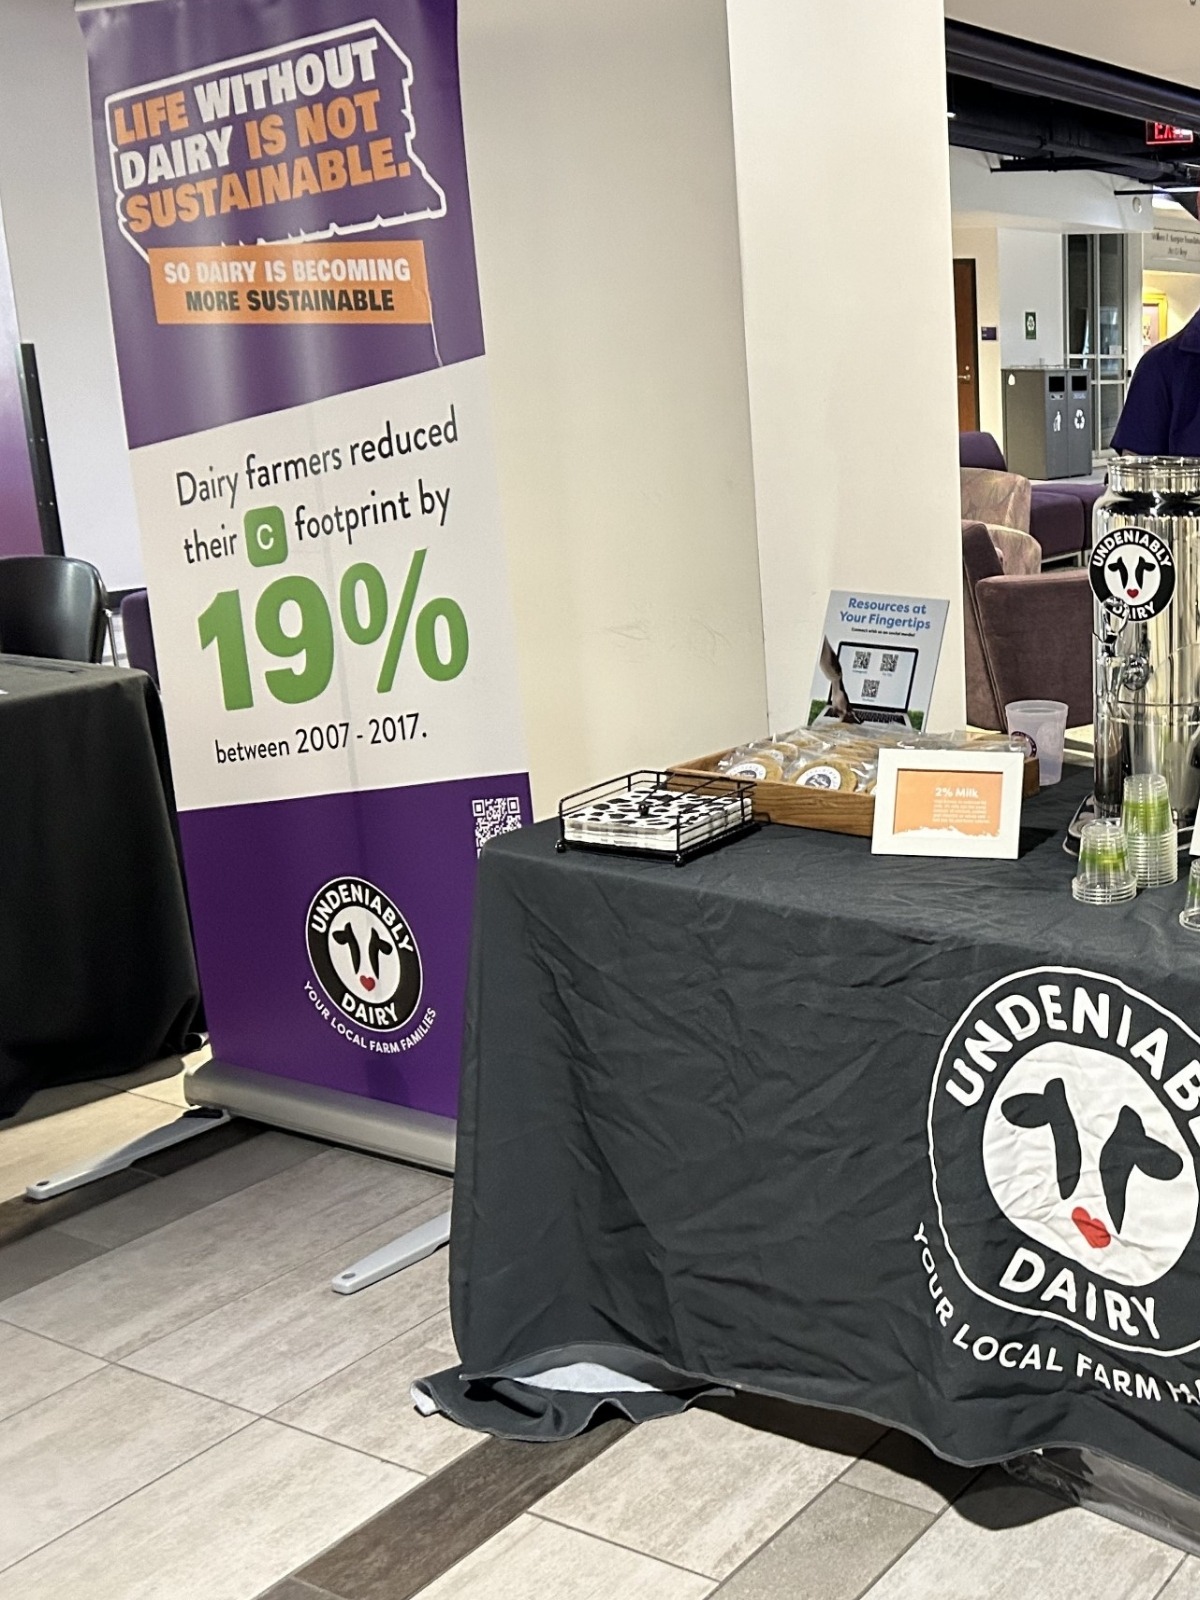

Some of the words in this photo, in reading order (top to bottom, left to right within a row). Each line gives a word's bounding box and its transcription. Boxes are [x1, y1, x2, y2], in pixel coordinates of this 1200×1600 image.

[113, 91, 188, 145] LIFE
[194, 37, 378, 123] WITHOUT
[119, 126, 233, 189] DAIRY
[245, 114, 287, 159] IS
[295, 89, 380, 148] NOT
[122, 137, 411, 233] SUSTAINABLE.
[164, 261, 189, 284] SO
[198, 260, 256, 283] DAIRY
[264, 260, 286, 282] IS
[293, 258, 410, 282] BECOMING
[186, 290, 240, 311] MORE
[247, 289, 394, 311] SUSTAINABLE
[175, 465, 238, 508] Dairy
[245, 447, 341, 490] farmers
[350, 404, 458, 466] reduced
[184, 524, 237, 564] their
[256, 524, 275, 550] C
[294, 488, 410, 545] footprint
[419, 479, 450, 526] by
[1092, 530, 1172, 567] UNDENIABLY
[198, 547, 469, 711] 19%
[840, 611, 866, 623] Your
[868, 613, 931, 631] Fingertips
[848, 597, 909, 613] Resources
[912, 604, 927, 614] at
[215, 740, 290, 764] between
[295, 722, 350, 754] 2007
[369, 713, 427, 744] 2017.
[935, 787, 954, 797] 2%
[955, 787, 979, 798] Milk
[311, 883, 414, 953] UNDENIABLY
[304, 981, 330, 1019] YOUR
[331, 1017, 367, 1048] LOCAL
[369, 1040, 400, 1053] FARM
[400, 1007, 436, 1050] FAMILIES
[341, 993, 398, 1025] DAIRY
[913, 1221, 954, 1327] YOUR
[952, 1323, 1063, 1372] LOCAL
[1076, 1352, 1161, 1401] FARM
[999, 1247, 1160, 1340] DAIRY
